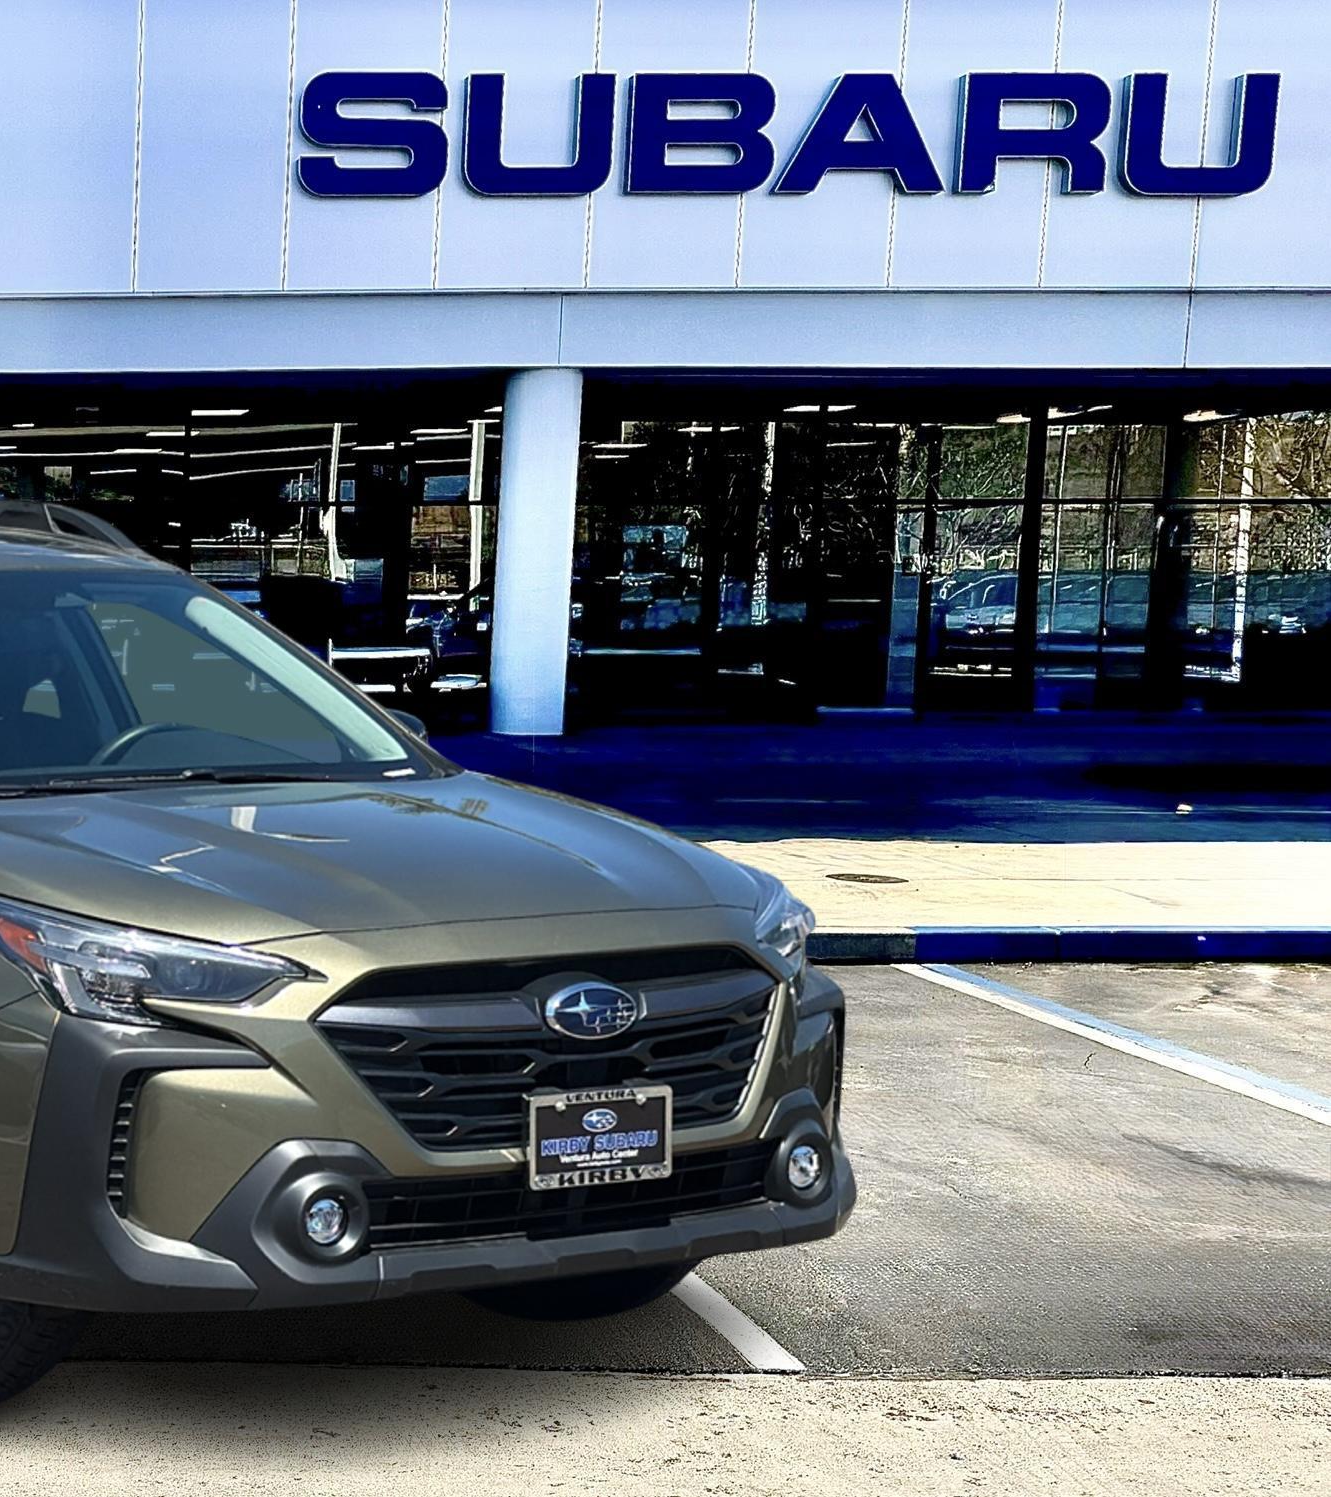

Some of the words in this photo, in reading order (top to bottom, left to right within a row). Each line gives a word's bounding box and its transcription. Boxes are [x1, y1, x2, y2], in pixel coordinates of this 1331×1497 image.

[297, 71, 1281, 198] SUBARU
[566, 1089, 637, 1103] VENTURA
[541, 1136, 591, 1157] KIRBY
[594, 1130, 658, 1151] SUBARU
[559, 1153, 590, 1164] Ventura
[591, 1150, 611, 1160] Auto
[612, 1148, 639, 1159] Center
[558, 1166, 645, 1187] KIRBY
